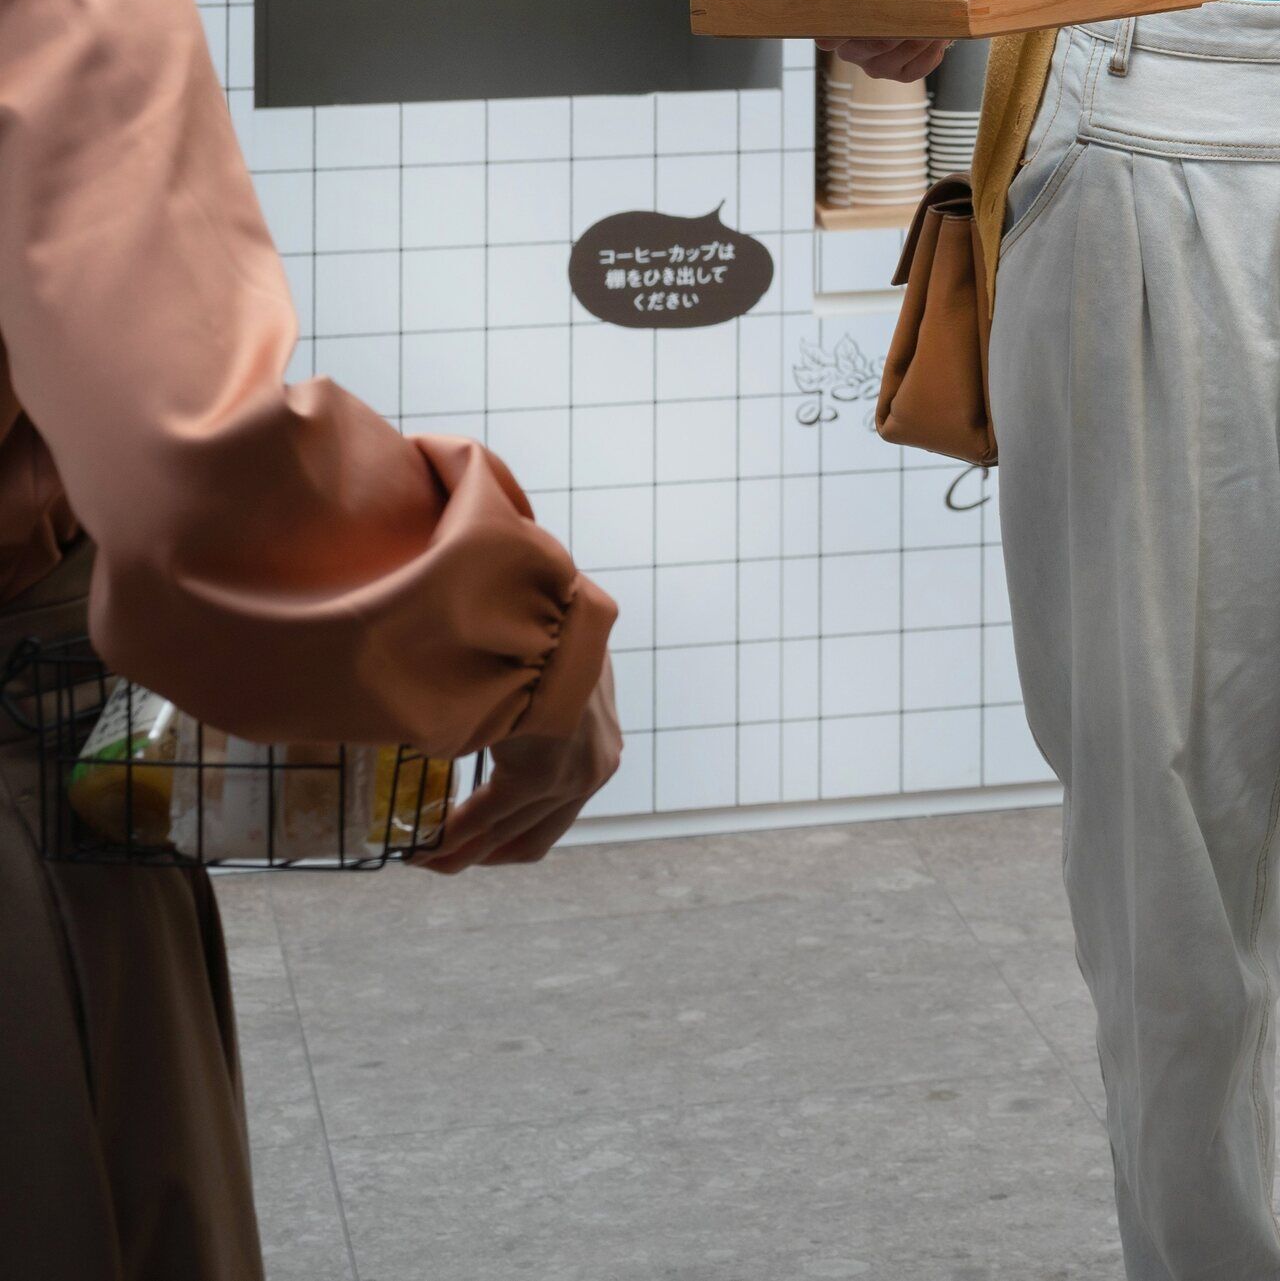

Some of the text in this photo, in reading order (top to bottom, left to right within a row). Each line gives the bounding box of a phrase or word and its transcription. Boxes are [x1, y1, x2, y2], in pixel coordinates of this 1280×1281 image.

[599, 241, 736, 265] コーヒーカップは
[605, 265, 728, 289] 棚をひき出して
[633, 292, 700, 311] ください
